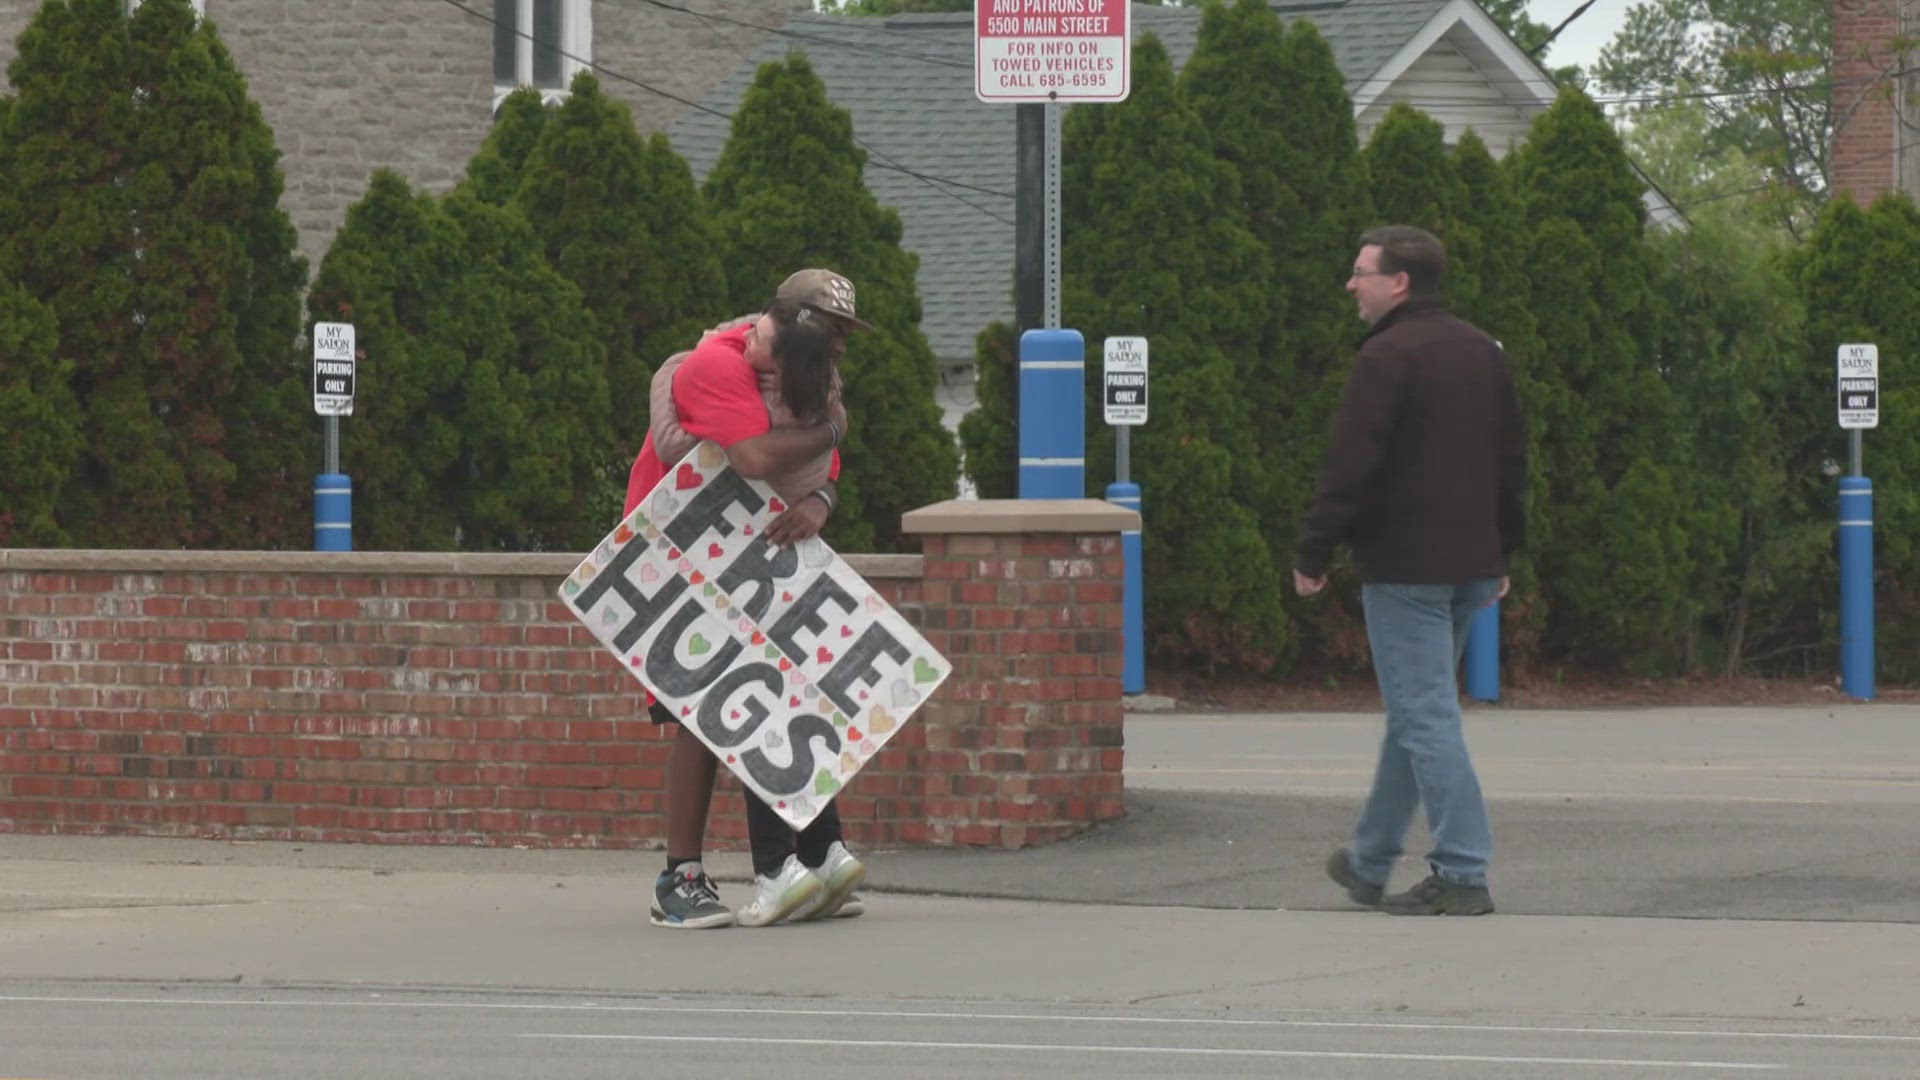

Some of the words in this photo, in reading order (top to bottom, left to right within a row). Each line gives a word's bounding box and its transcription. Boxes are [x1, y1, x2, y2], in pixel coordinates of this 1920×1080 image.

[993, 0, 1019, 13] AND
[1024, 0, 1085, 13] PATRONS
[1088, 0, 1105, 13] OF
[988, 17, 1019, 34] 5500
[1024, 17, 1057, 34] MAIN
[1061, 17, 1109, 34] STREET
[1008, 42, 1035, 56] FOR
[1041, 42, 1073, 55] INFO
[1079, 42, 1097, 55] ON
[992, 58, 1041, 72] TOWED
[1046, 58, 1113, 71] VEHICLES
[1000, 74, 1035, 88] CALL
[1040, 74, 1106, 87] 685-6595
[326, 326, 342, 337] MY
[317, 338, 350, 349] SALON
[1117, 340, 1133, 350] MY
[1108, 352, 1142, 363] SALON
[1850, 347, 1865, 357] MY
[317, 362, 352, 376] PARKING
[1841, 358, 1873, 369] SALON
[325, 379, 345, 392] ONLY
[1108, 375, 1145, 386] PARKING
[1841, 380, 1875, 392] PARKING
[1115, 391, 1137, 403] ONLY
[1848, 396, 1869, 408] ONLY
[663, 466, 912, 719] FREE
[573, 533, 841, 795] HUGS
